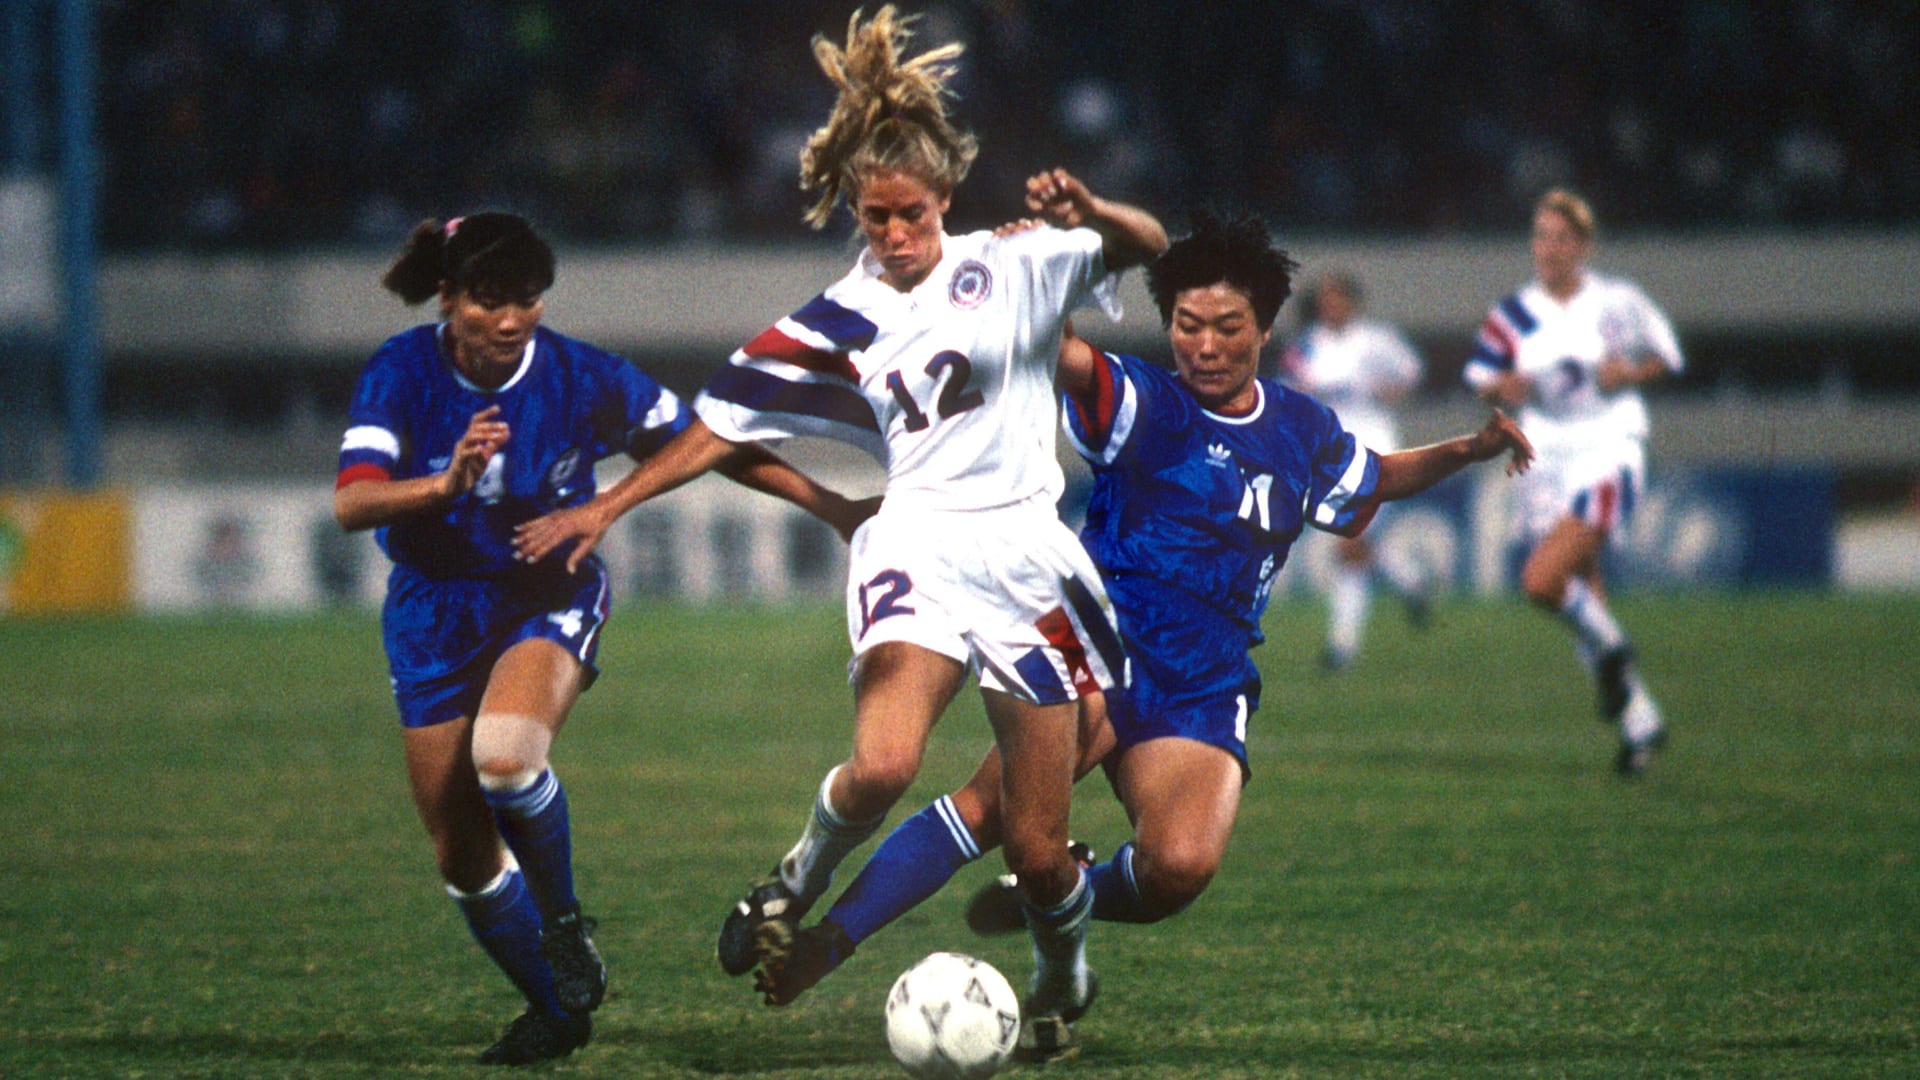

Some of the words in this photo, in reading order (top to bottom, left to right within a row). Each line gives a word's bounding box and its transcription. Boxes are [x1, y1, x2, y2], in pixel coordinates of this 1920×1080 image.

[885, 349, 985, 433] 12
[1237, 473, 1273, 532] 11
[546, 608, 584, 639] 4
[857, 568, 916, 642] 12
